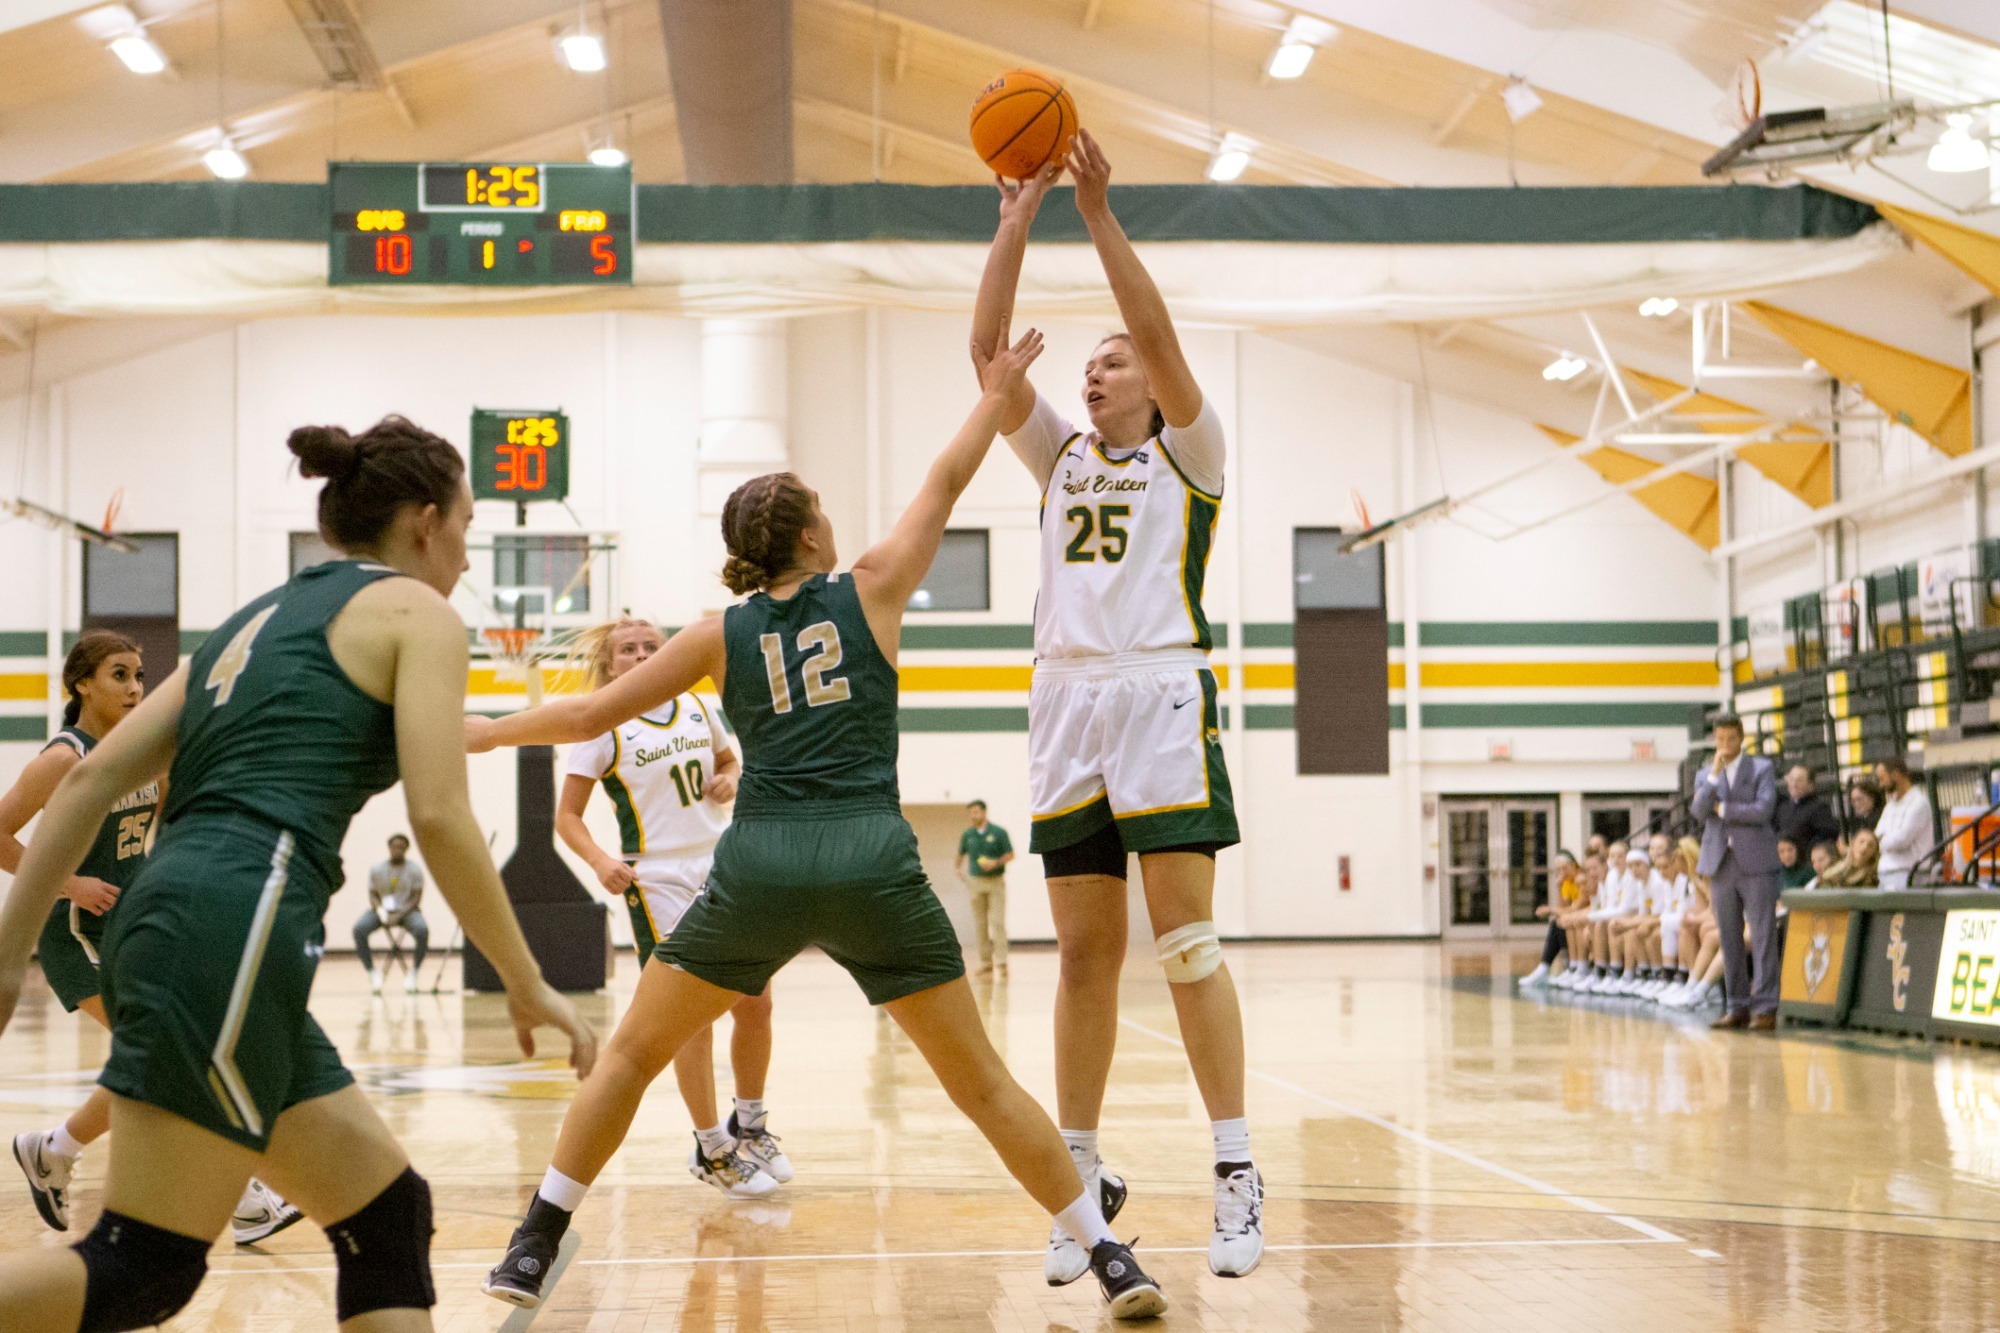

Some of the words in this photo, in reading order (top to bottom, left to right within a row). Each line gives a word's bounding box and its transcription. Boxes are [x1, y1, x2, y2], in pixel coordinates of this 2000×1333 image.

[466, 166, 539, 207] 1:25
[559, 210, 607, 232] FRA
[375, 234, 412, 275] 10
[482, 240, 495, 269] 1
[590, 235, 617, 275] 5
[507, 417, 559, 448] 1:25
[495, 444, 546, 491] 30
[1065, 503, 1131, 564] 25
[205, 602, 279, 708] 4
[760, 620, 851, 715] 12
[635, 743, 673, 768] Saint
[669, 758, 703, 808] 10
[116, 811, 152, 861] 25
[1960, 918, 1998, 941] SAINT
